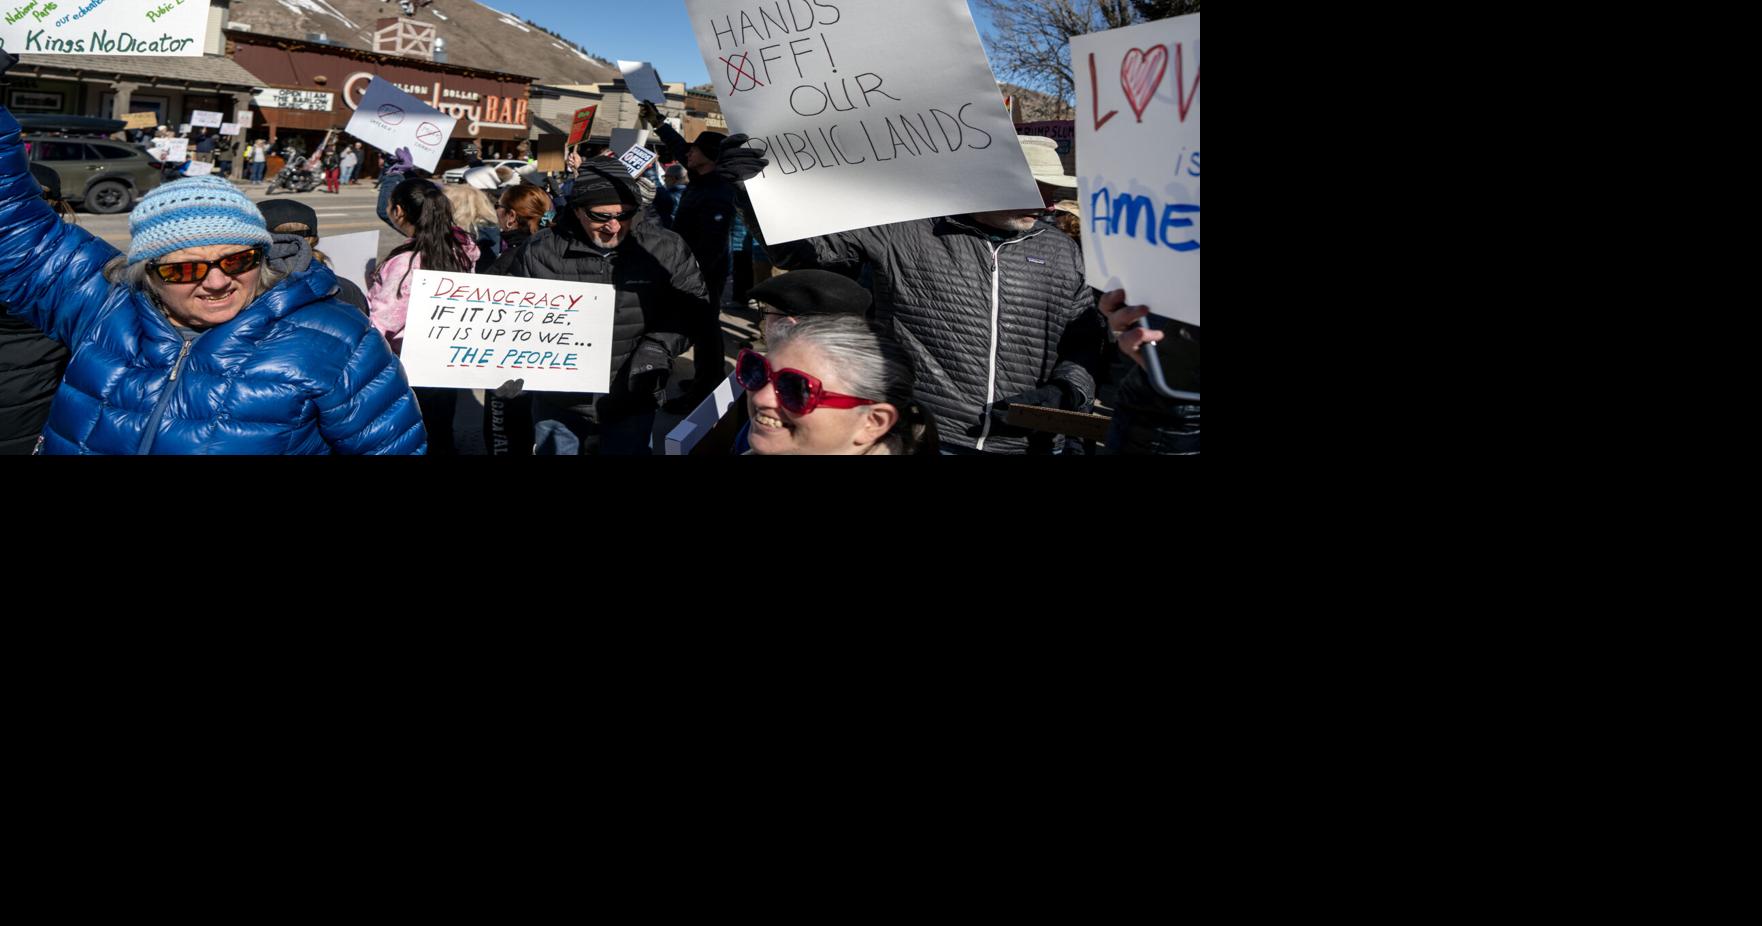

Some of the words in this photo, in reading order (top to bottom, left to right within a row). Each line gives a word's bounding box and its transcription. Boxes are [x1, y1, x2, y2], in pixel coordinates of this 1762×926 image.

[56, 14, 70, 28] our
[711, 0, 840, 50] HANDS
[26, 29, 85, 53] Kings
[443, 88, 480, 101] DOLLAR
[790, 72, 901, 117] OUR
[485, 95, 528, 125] BAR
[860, 103, 992, 161] LANDS
[1091, 187, 1200, 252] AME
[434, 277, 583, 311] DEMOCRACY
[430, 304, 455, 321] IF
[460, 307, 483, 322] IT
[486, 308, 507, 323] IS
[514, 309, 534, 323] TO
[428, 326, 450, 338] IT
[452, 327, 472, 341] IS
[481, 328, 506, 342] UP
[512, 329, 532, 342] TO
[450, 345, 495, 364] THE
[500, 349, 578, 366] PEOPLE
